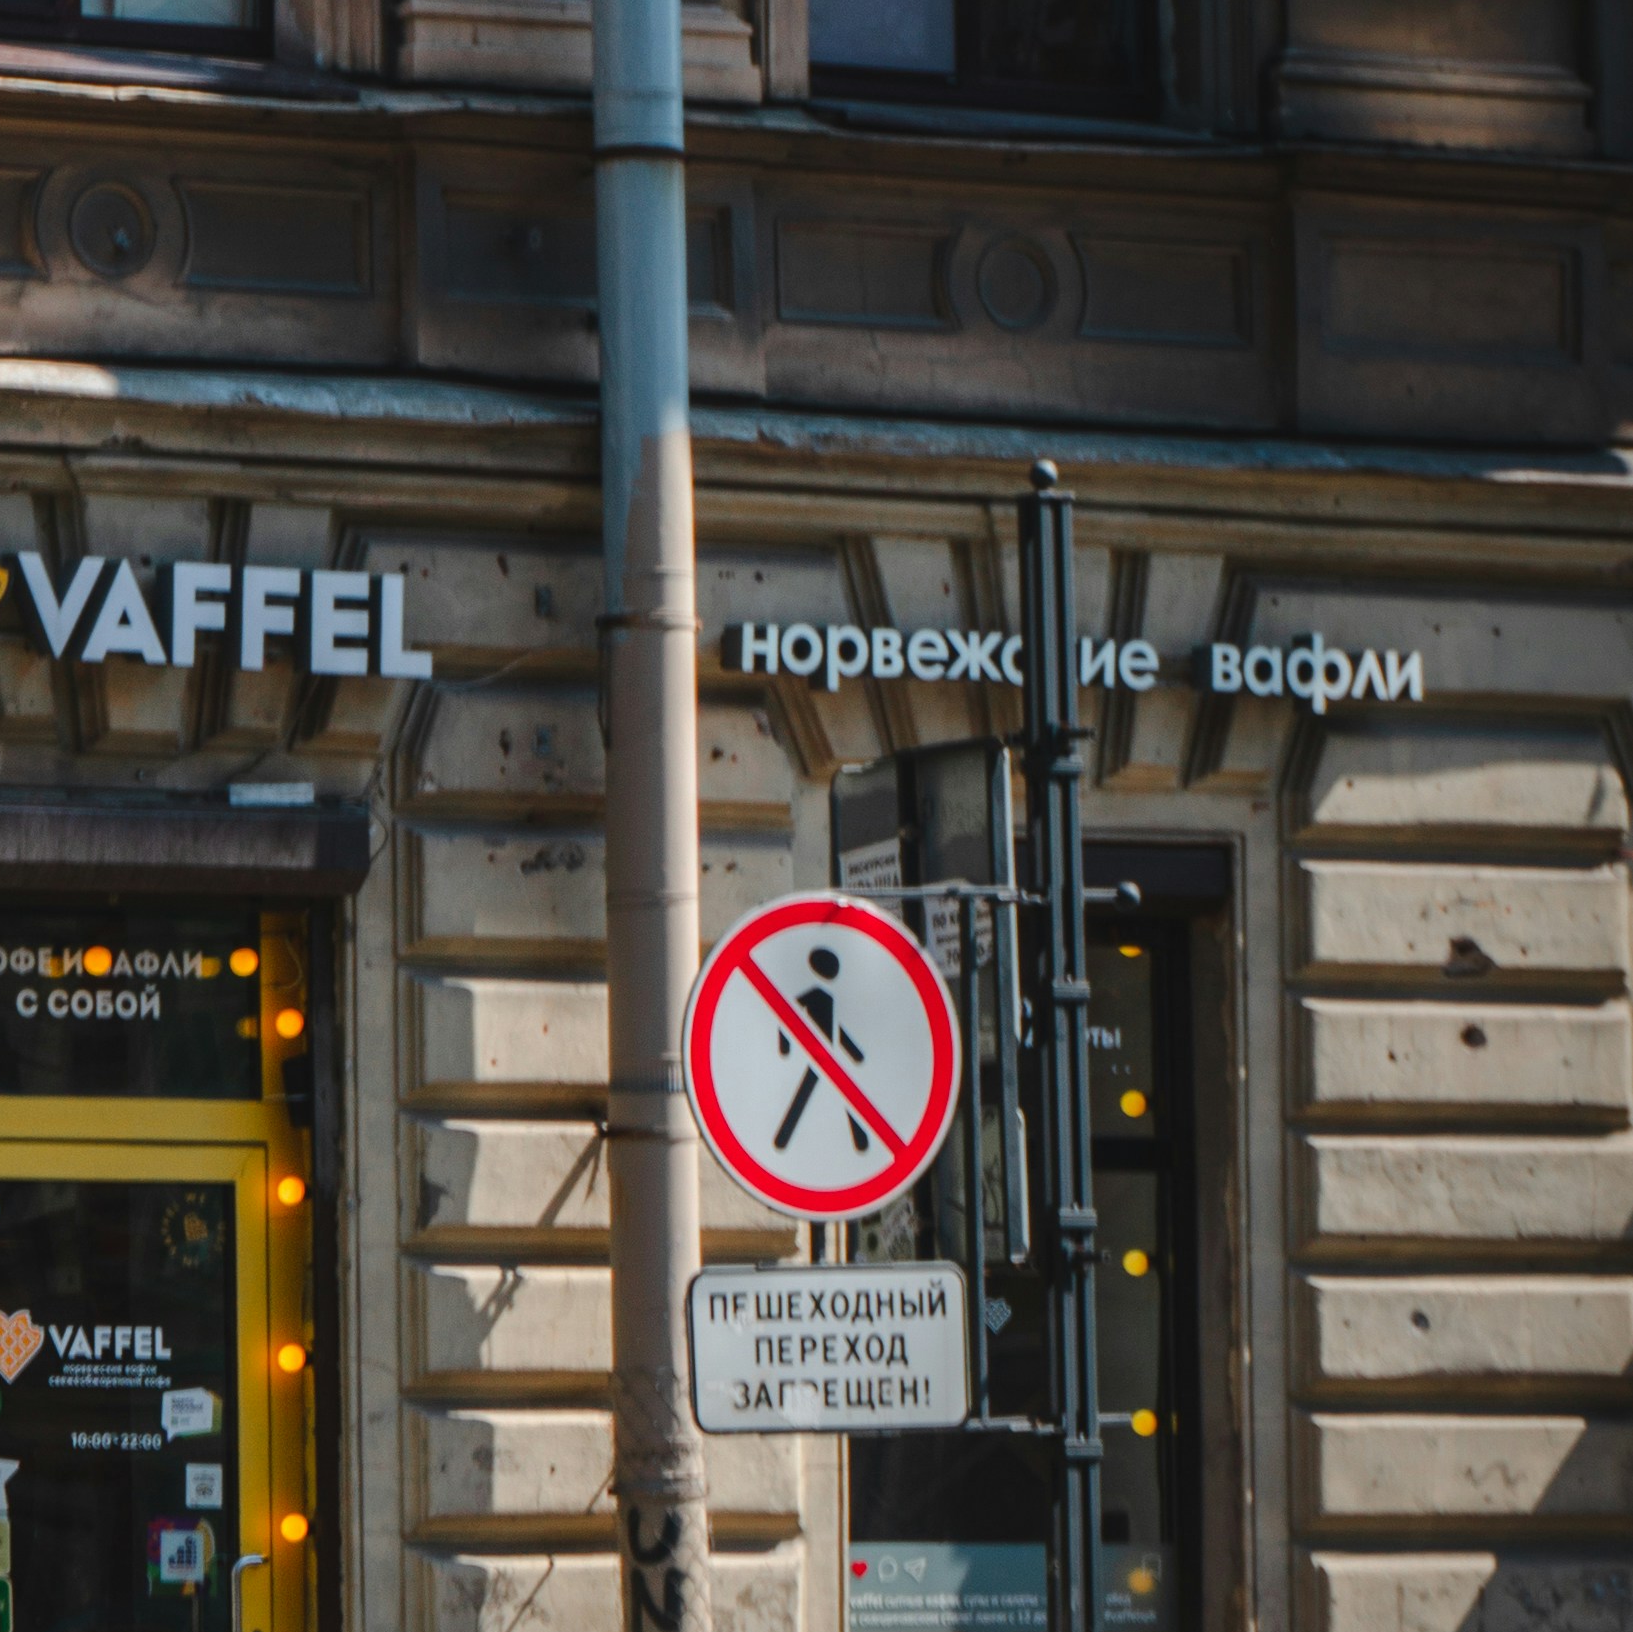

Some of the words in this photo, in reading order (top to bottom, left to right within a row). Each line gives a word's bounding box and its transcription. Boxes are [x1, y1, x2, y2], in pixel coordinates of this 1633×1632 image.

[17, 550, 433, 680] VAFFEL
[741, 621, 1160, 694] норвежсие
[1212, 632, 1424, 715] вафли
[63, 947, 83, 976] И
[88, 948, 203, 980] АФЛИ
[16, 988, 38, 1019] С
[47, 983, 162, 1020] СОБОЙ
[708, 1278, 947, 1324] ПЕШЕХОДНЫЙ
[48, 1324, 172, 1360] VAFFEL
[754, 1333, 909, 1367] ПЕРЕХОД
